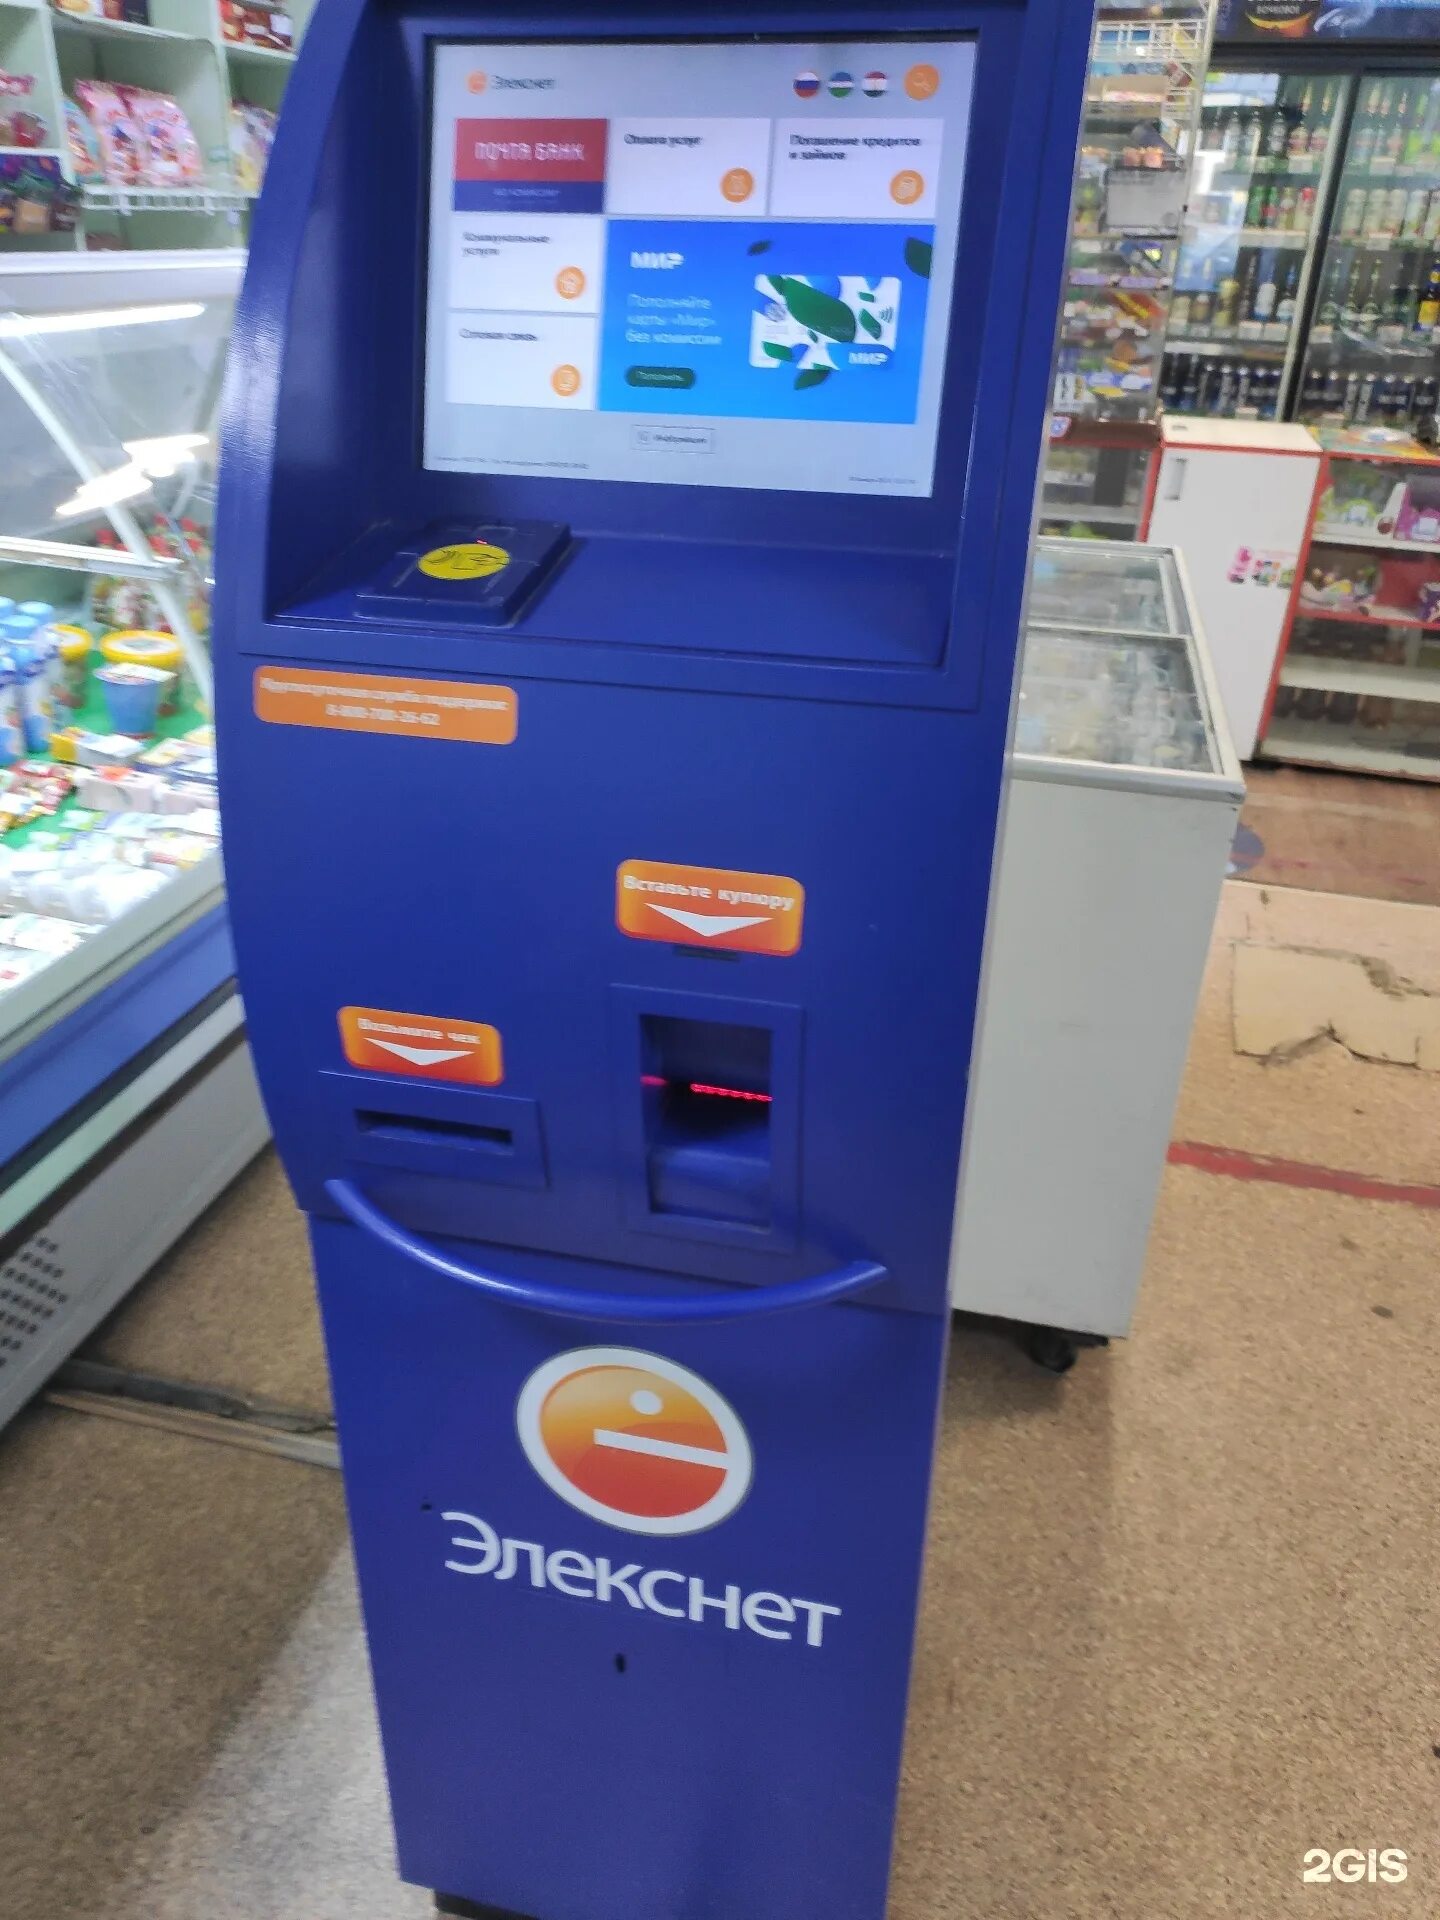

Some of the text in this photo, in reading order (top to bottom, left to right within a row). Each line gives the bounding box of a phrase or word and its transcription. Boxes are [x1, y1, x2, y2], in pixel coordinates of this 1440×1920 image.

[474, 142, 585, 160] ПОЧТА БАНК
[630, 251, 685, 269] МИР
[623, 874, 795, 912] Вставьте купюру
[447, 1032, 481, 1045] чек
[440, 1510, 843, 1648] Элекснет
